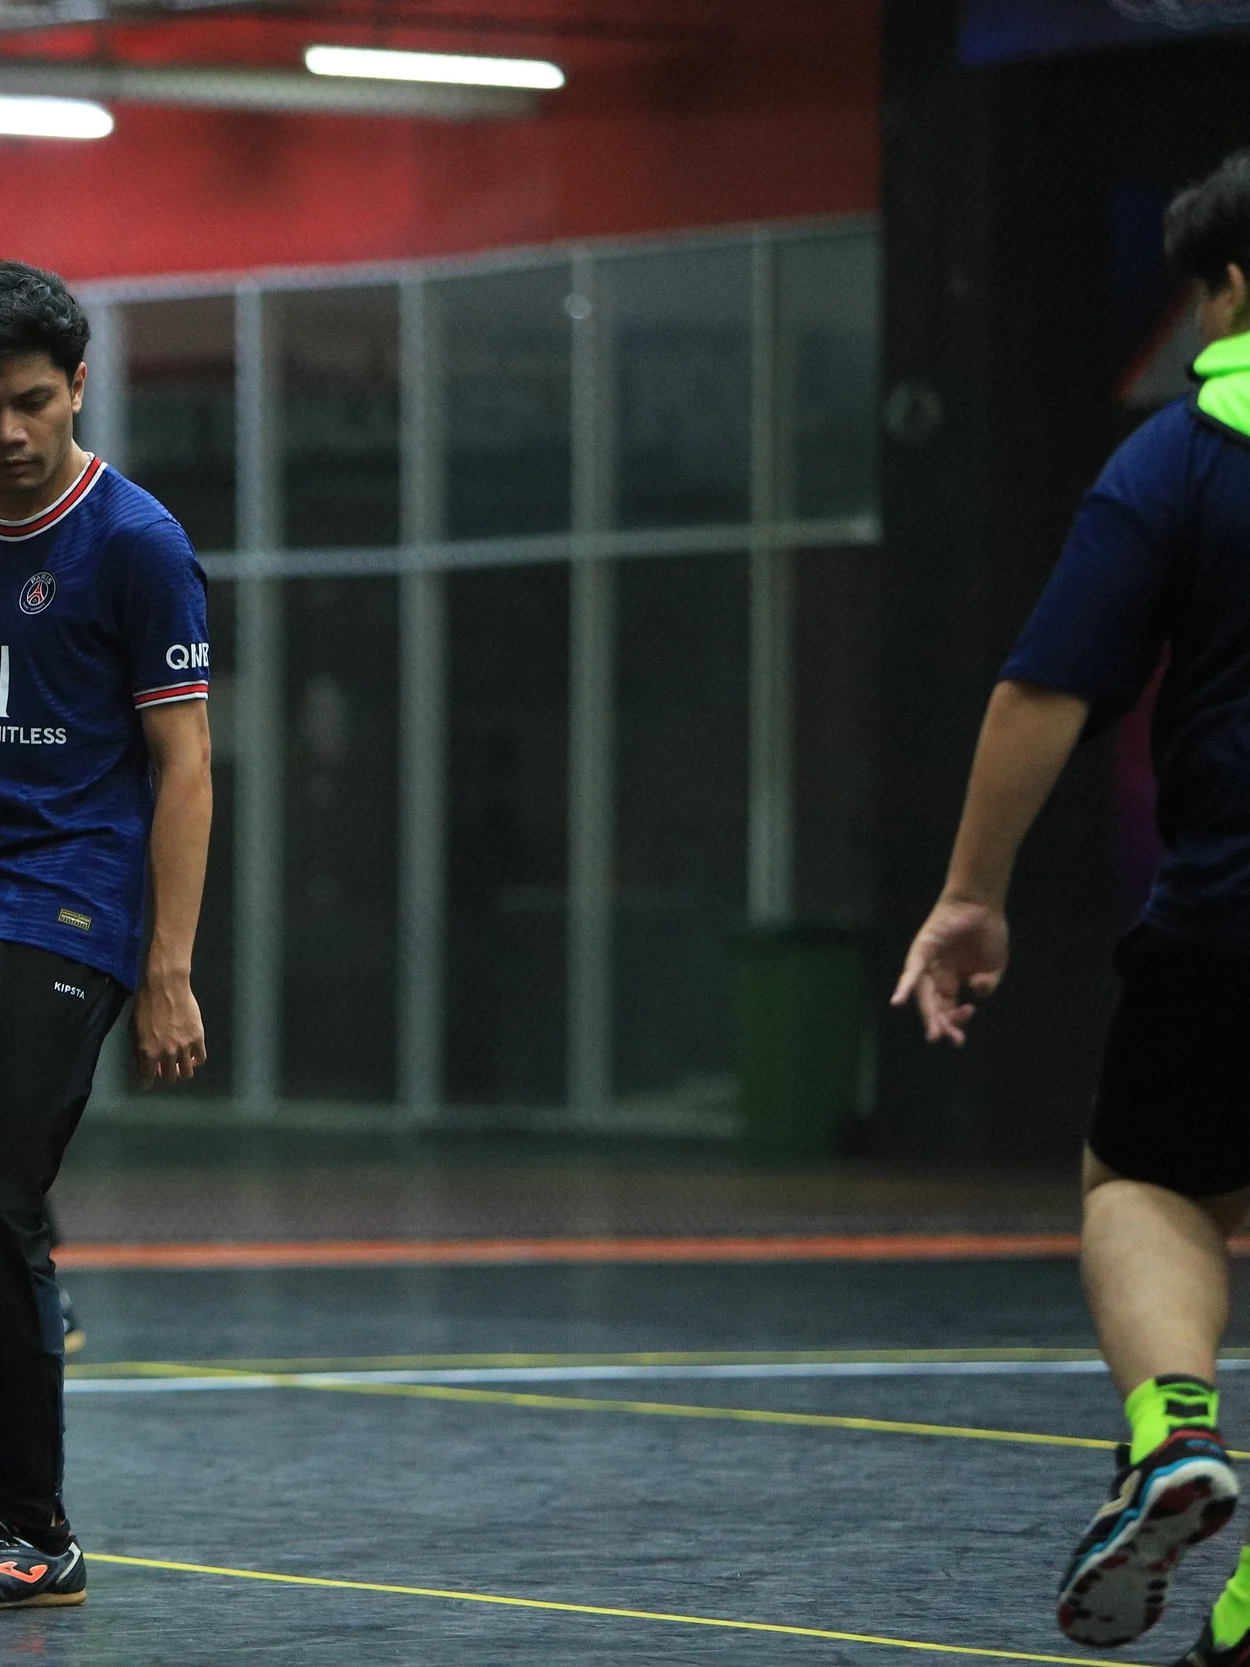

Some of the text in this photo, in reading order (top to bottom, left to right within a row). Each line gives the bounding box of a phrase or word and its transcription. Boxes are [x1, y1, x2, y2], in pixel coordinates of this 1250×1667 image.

[30, 573, 53, 585] PARIS
[165, 642, 210, 670] QNB
[54, 981, 86, 1000] KIPSTA
